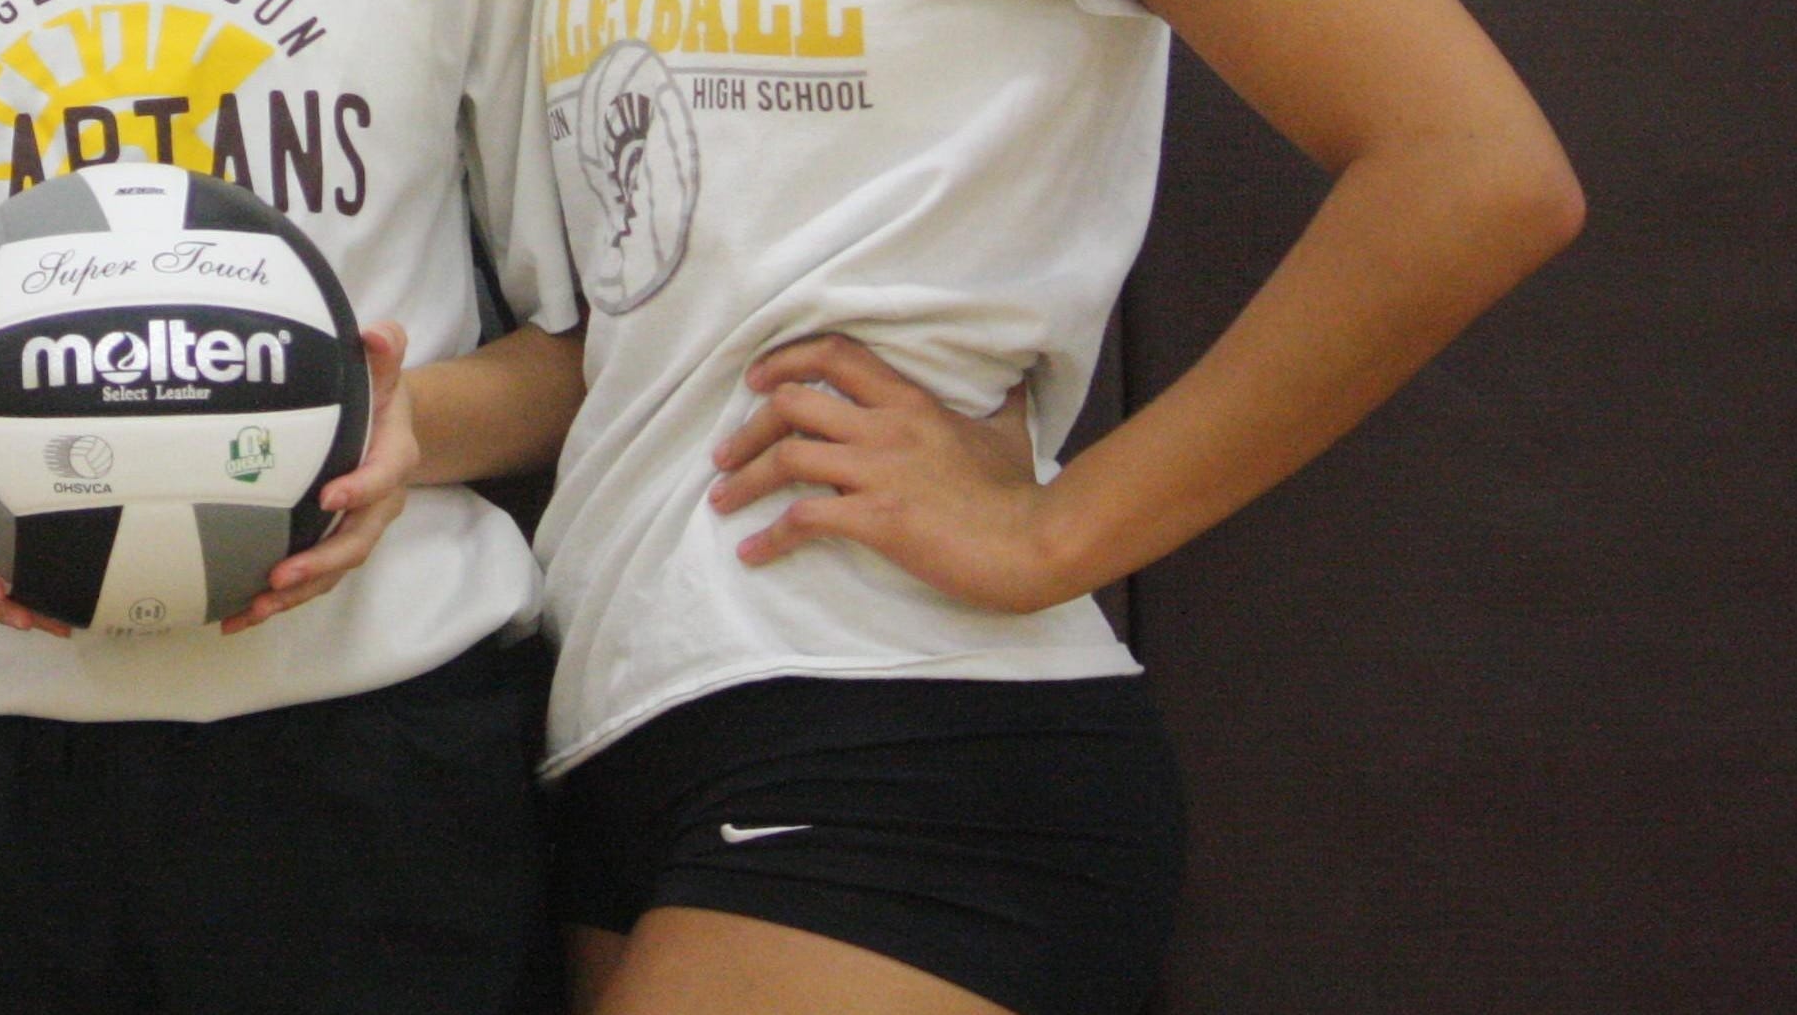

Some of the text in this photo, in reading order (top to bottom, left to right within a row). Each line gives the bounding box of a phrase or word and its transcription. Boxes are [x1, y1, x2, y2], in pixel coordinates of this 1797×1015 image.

[693, 78, 746, 110] HIGH
[758, 79, 874, 112] SCHOOL
[21, 240, 269, 296] Super Touch
[21, 319, 287, 390] molten
[102, 384, 211, 402] Select Leather
[53, 482, 113, 495] OHSVCA
